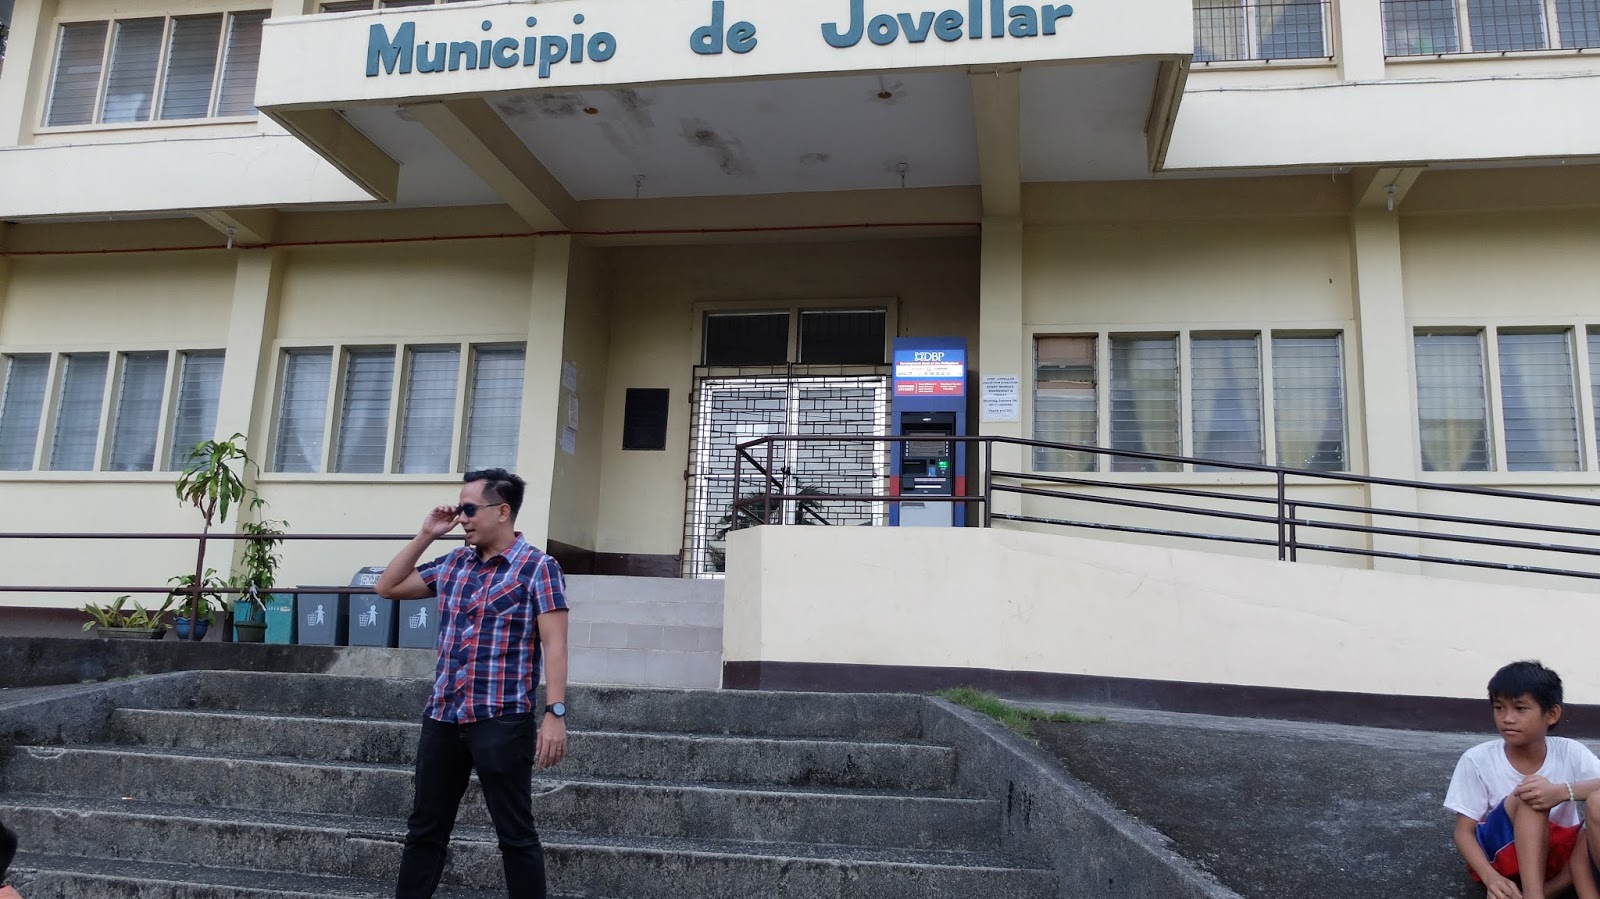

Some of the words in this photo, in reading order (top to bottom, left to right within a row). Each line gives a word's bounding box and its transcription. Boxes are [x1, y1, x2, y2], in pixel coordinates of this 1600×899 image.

[366, 13, 616, 78] Municipio
[690, 0, 757, 54] de
[821, 0, 1073, 48] Jovellar
[924, 352, 945, 361] DBP
